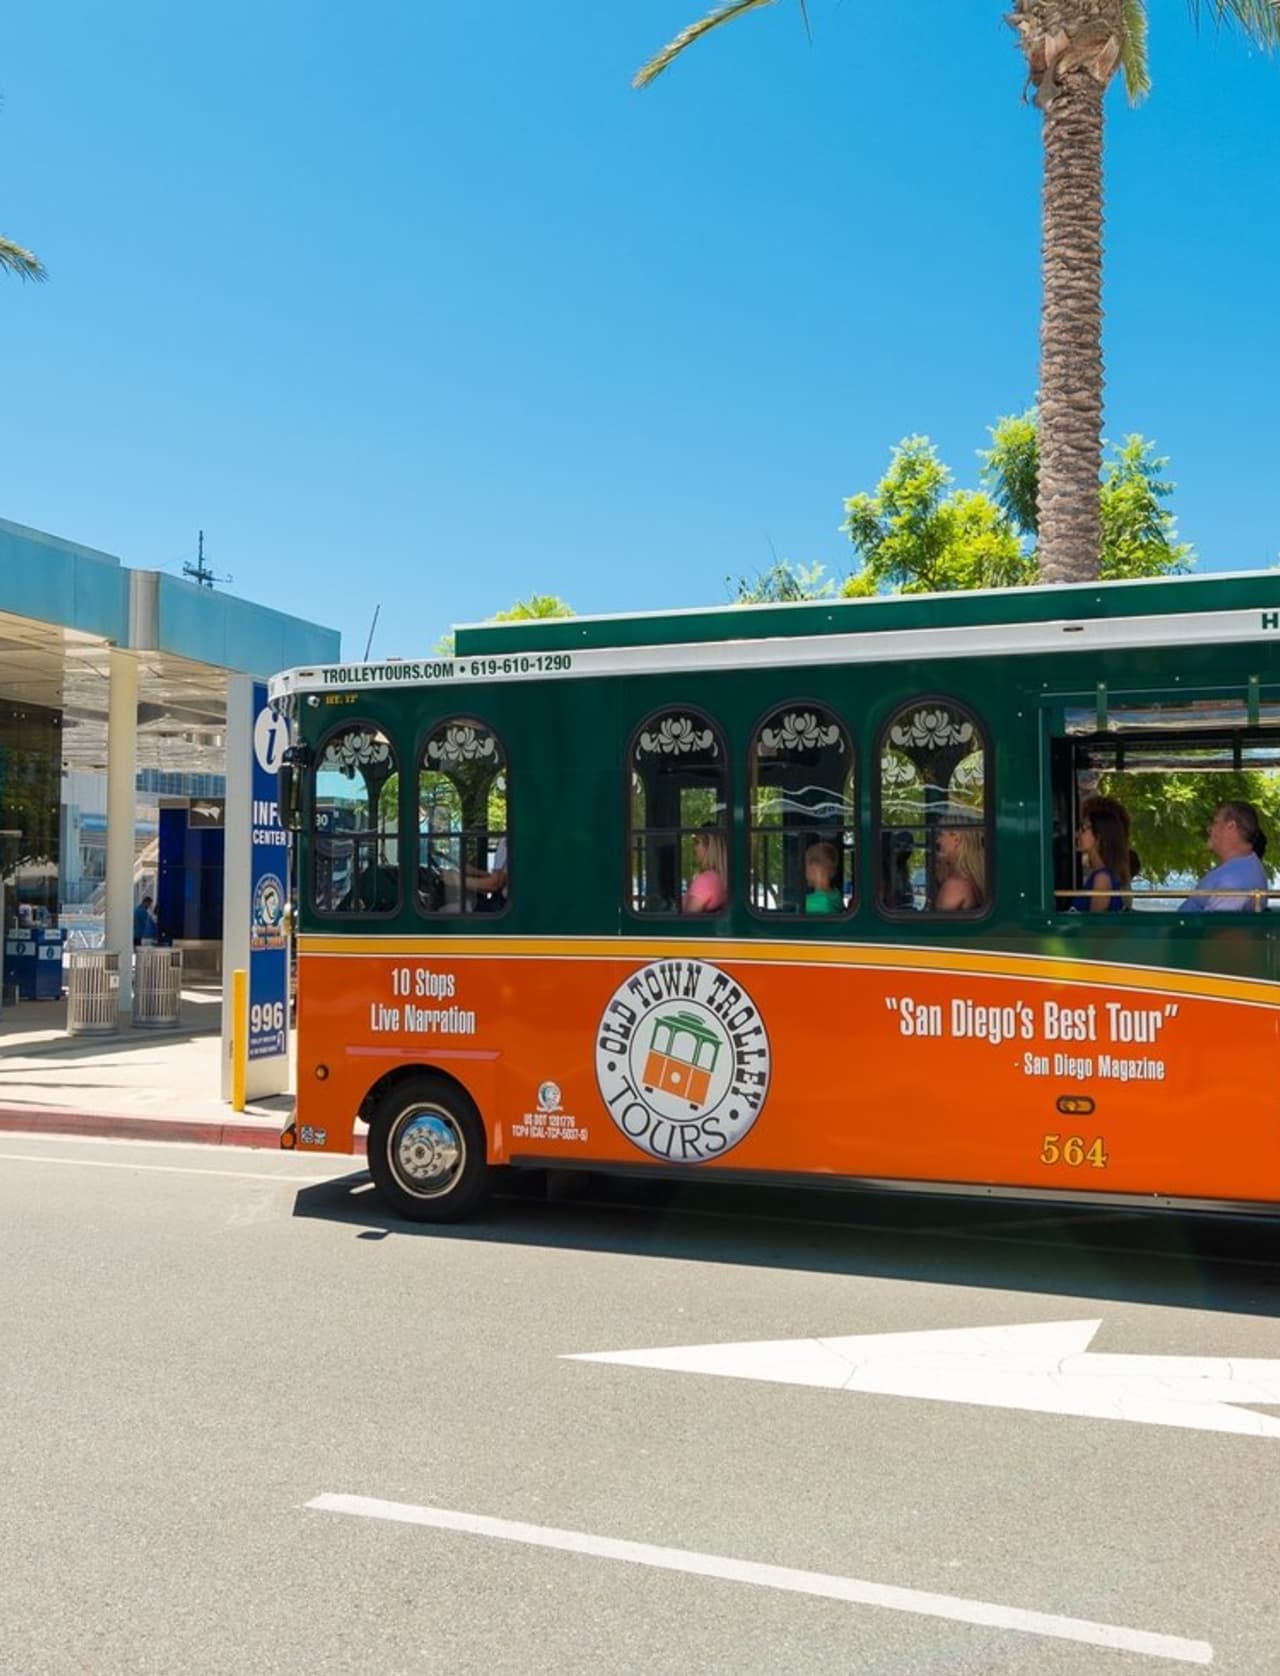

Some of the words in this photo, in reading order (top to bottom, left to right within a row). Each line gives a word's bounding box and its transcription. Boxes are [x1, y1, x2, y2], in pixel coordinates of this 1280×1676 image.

[322, 663, 454, 684] TROLLEYTOURS.COM
[471, 654, 572, 676] 619-610-1290
[253, 801, 283, 828] INF
[253, 829, 287, 846] CENTER
[392, 967, 410, 996] 10
[415, 967, 455, 1001] Stops
[251, 1001, 284, 1034] 996
[371, 1003, 400, 1031] Live
[404, 1003, 476, 1035] Narration
[1044, 1002, 1098, 1042] Best
[599, 999, 637, 1055] OLD
[627, 962, 702, 1009] TOWN
[706, 972, 767, 1110] TROLLEY
[1023, 1052, 1050, 1076] San
[1054, 1054, 1094, 1080] Diego
[1097, 1056, 1166, 1082] Magazine
[608, 1074, 727, 1159] TOURS
[1040, 1134, 1107, 1168] 564
